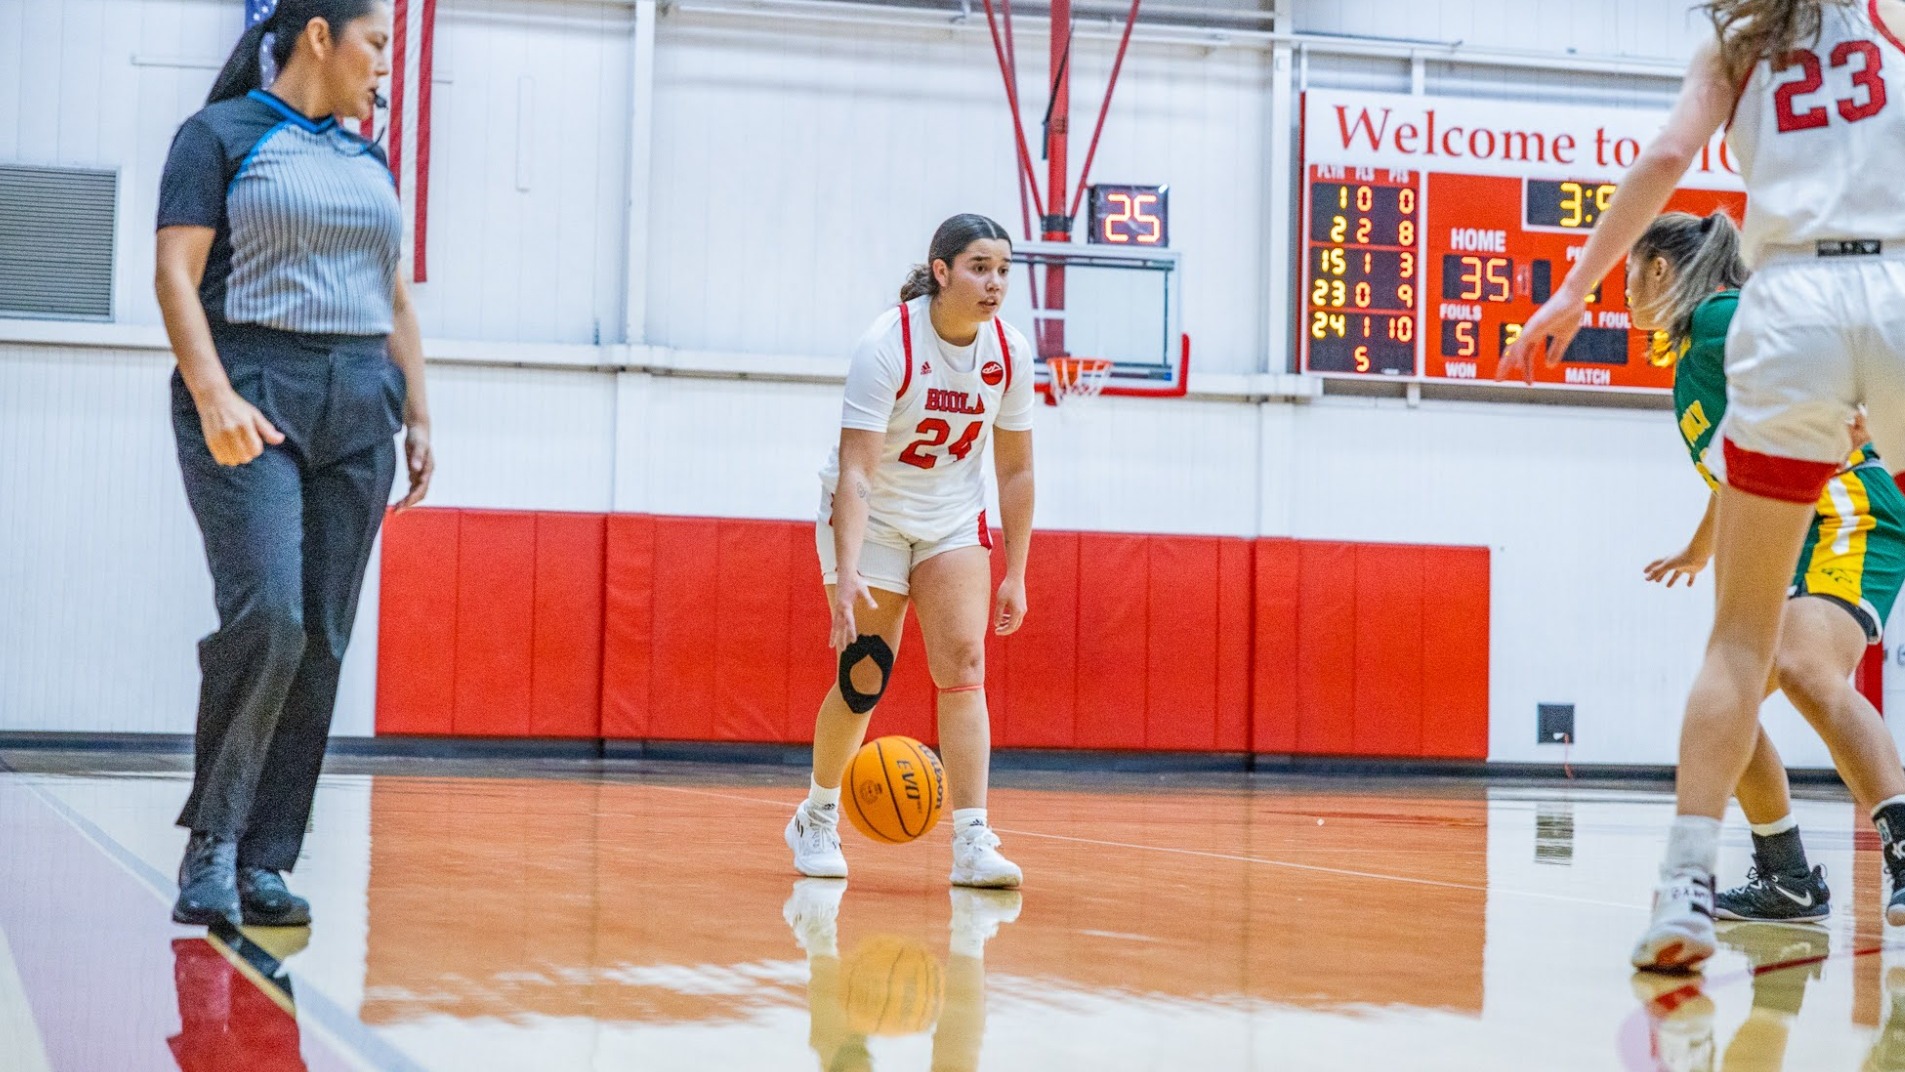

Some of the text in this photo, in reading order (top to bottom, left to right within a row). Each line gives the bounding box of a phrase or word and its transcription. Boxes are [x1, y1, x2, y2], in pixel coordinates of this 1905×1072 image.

[1771, 40, 1886, 133] 23
[1333, 105, 1576, 165] Welcome
[1594, 127, 1641, 169] to
[1339, 186, 1414, 214] 1 0 0
[1105, 193, 1161, 243] 25
[1330, 215, 1414, 247] 2 2 8
[1451, 227, 1507, 253] HOME
[1321, 247, 1413, 278] 15 1 3
[1312, 278, 1413, 308] 23 0 9
[1460, 256, 1510, 302] 35
[1311, 311, 1413, 342] 24 1 10
[1439, 302, 1482, 321] FOULS
[1455, 321, 1475, 356] 5
[1354, 345, 1370, 372] 5
[1444, 361, 1478, 379] WON
[1565, 367, 1611, 385] MATCH
[925, 388, 985, 415] BIOLA
[898, 417, 984, 470] 24
